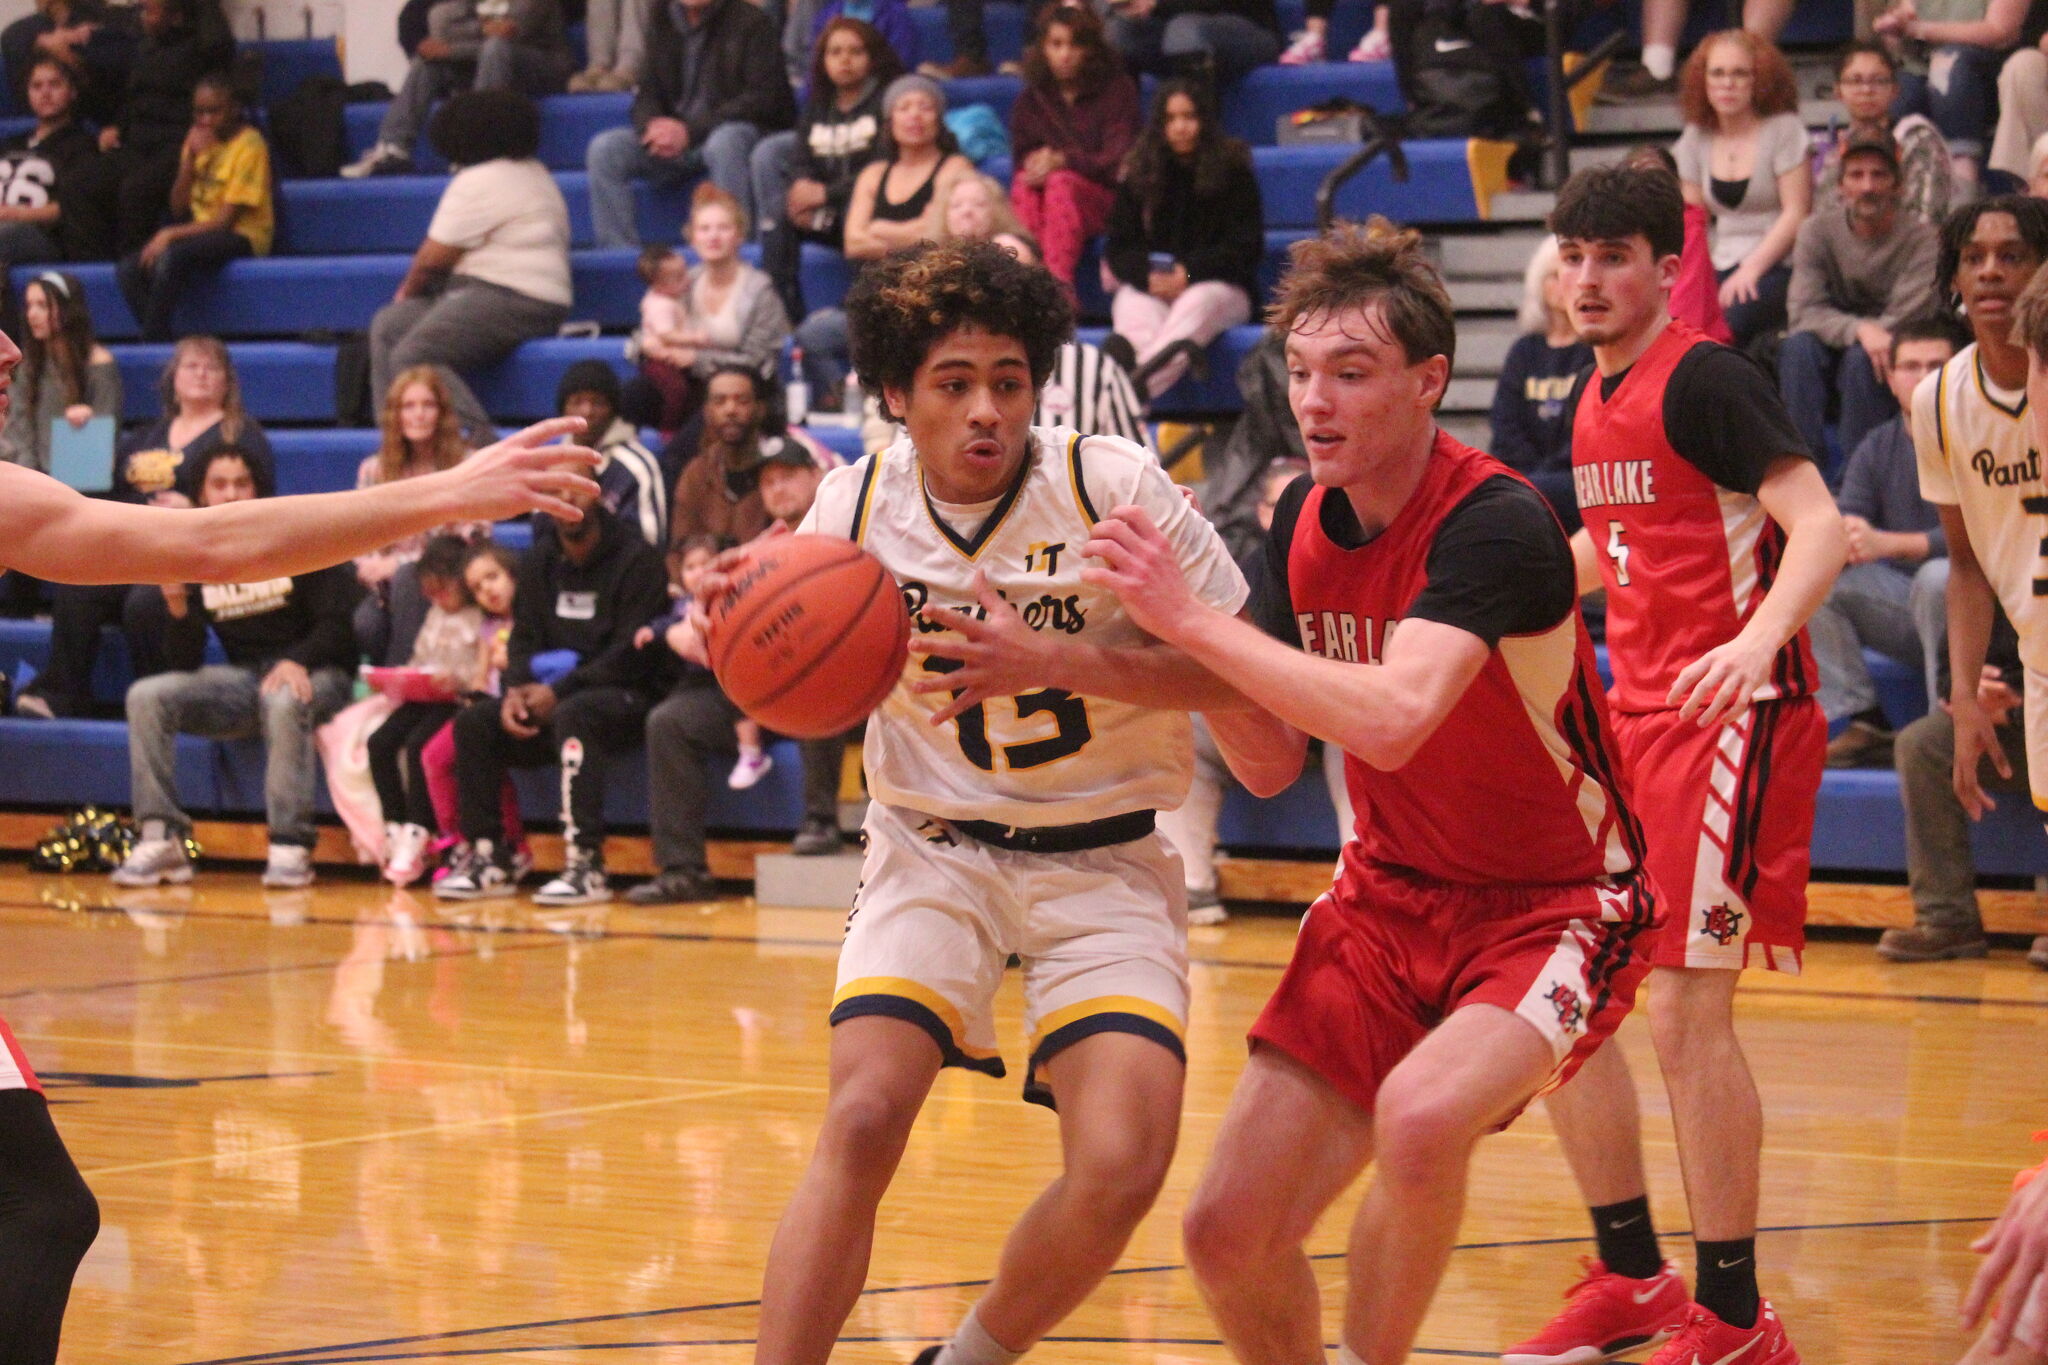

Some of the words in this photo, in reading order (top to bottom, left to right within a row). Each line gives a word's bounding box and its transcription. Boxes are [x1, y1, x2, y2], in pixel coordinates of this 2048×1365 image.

[1603, 459, 1657, 505] LAKE
[1971, 448, 2043, 487] Pant
[1606, 519, 1630, 586] 5
[1297, 611, 1360, 663] EAR
